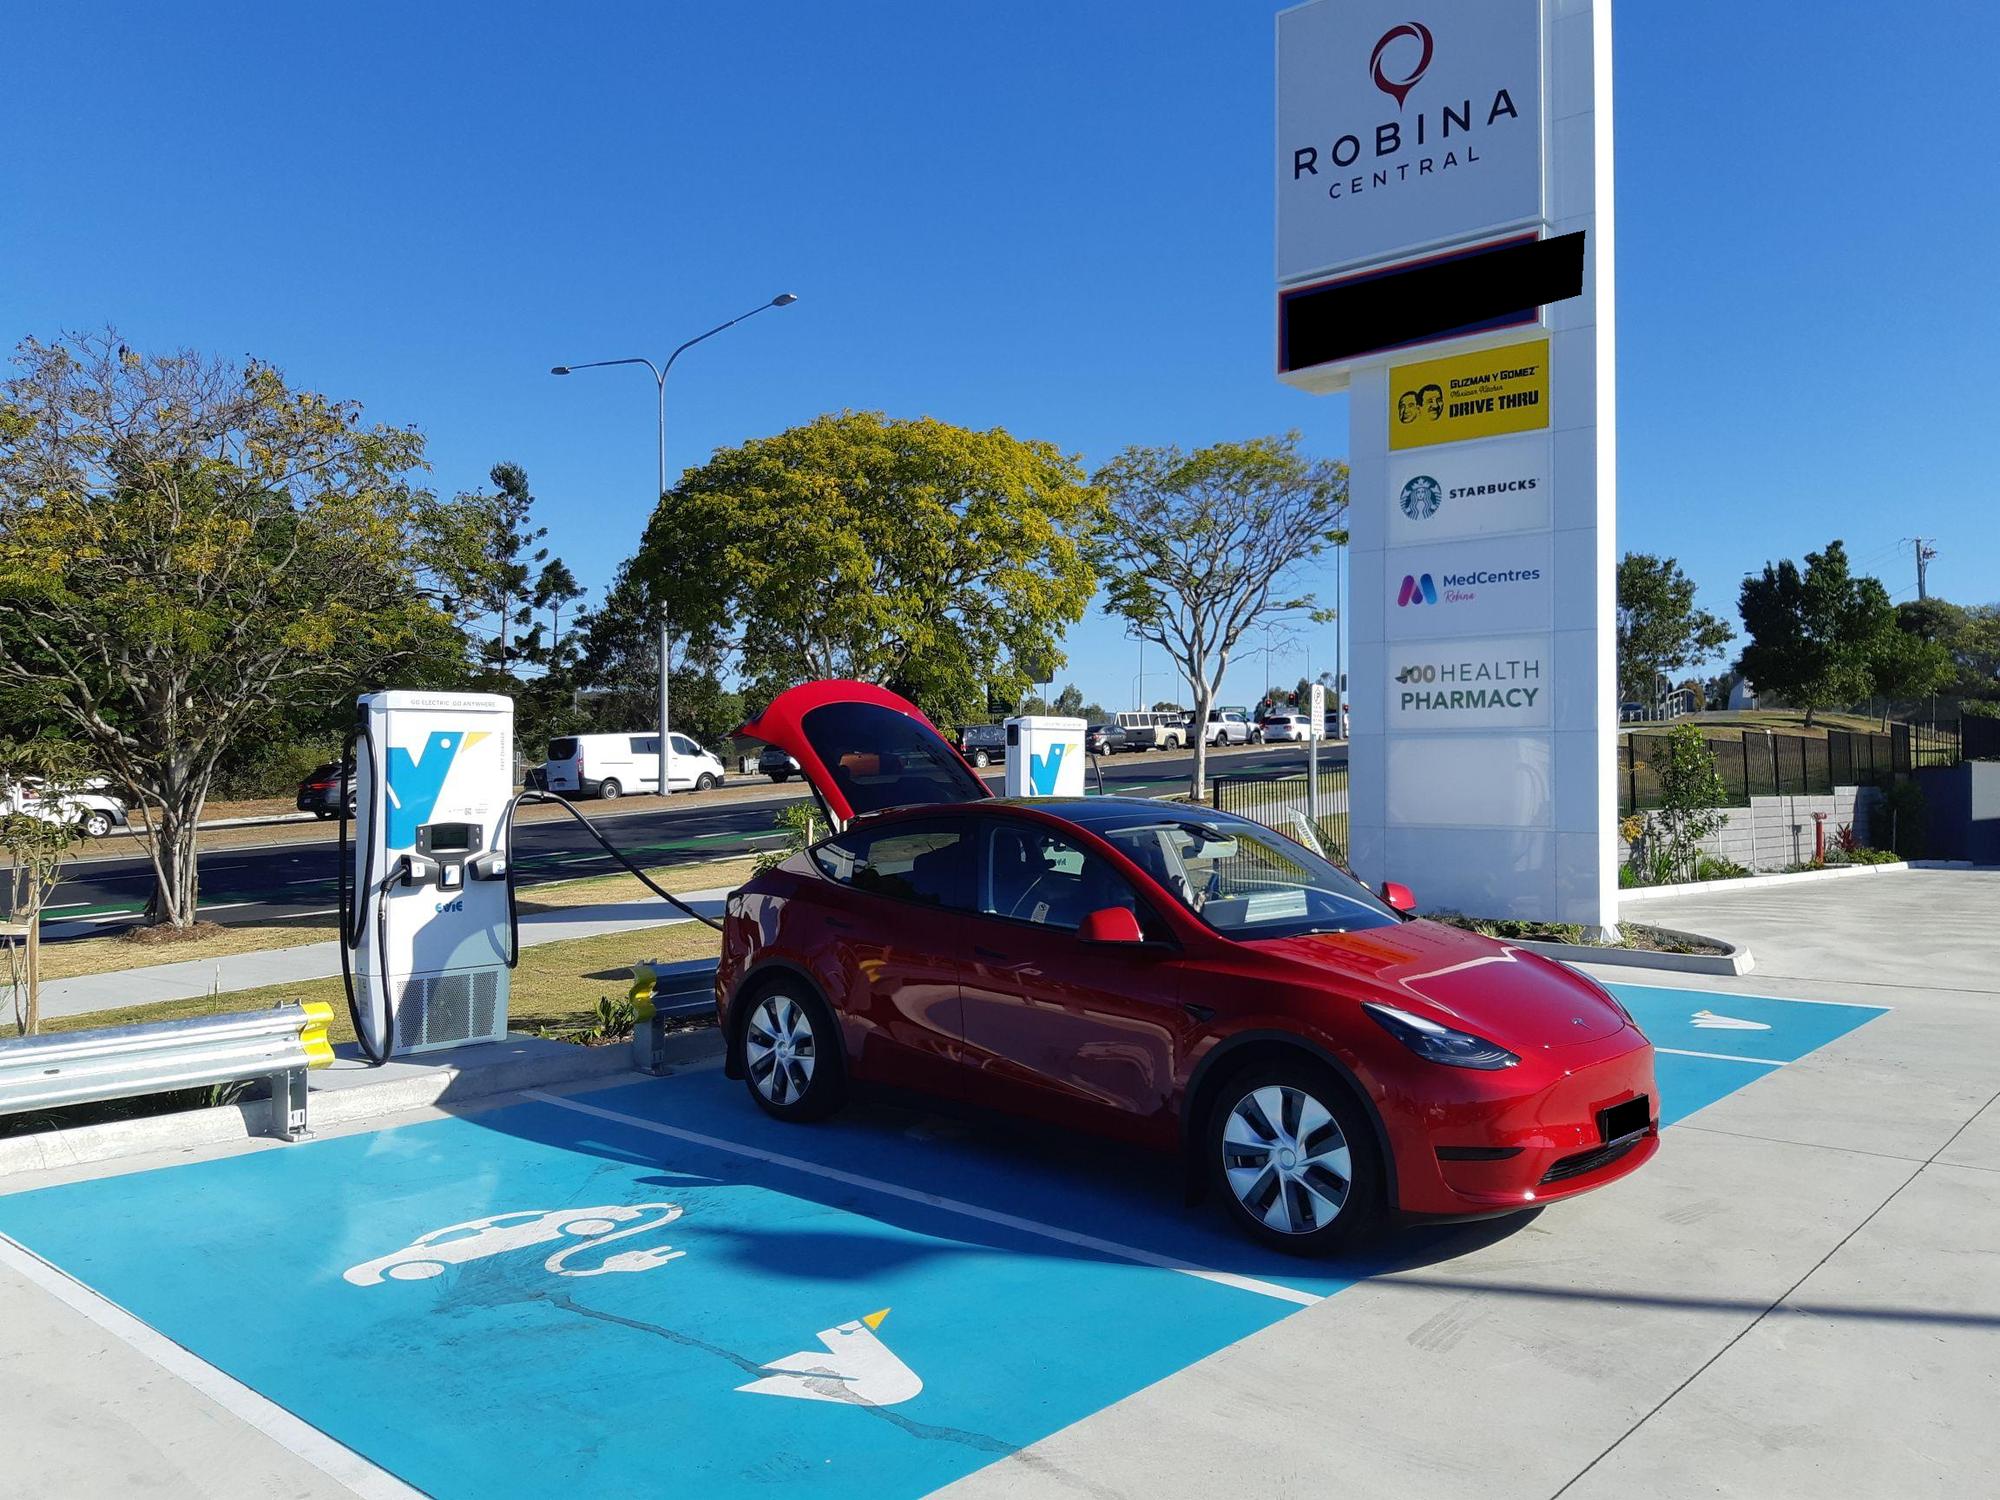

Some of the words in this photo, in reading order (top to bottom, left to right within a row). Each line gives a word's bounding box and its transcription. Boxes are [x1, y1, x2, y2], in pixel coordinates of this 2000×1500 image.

[1294, 88, 1519, 180] ROBINA
[1328, 146, 1480, 199] CENTRAL
[1450, 374, 1490, 389] GUZMAN
[1492, 373, 1499, 382] Y
[1450, 389, 1478, 398] Mexican
[1479, 384, 1504, 394] Kitchen
[1449, 397, 1494, 418] DRIVE
[1498, 390, 1539, 410] THRU
[1449, 478, 1537, 499] STARBUCKS
[1443, 569, 1540, 587] MedCentres
[1444, 590, 1475, 603] Robina
[1441, 660, 1539, 682] HEALTH
[1401, 688, 1539, 711] PHARMACY
